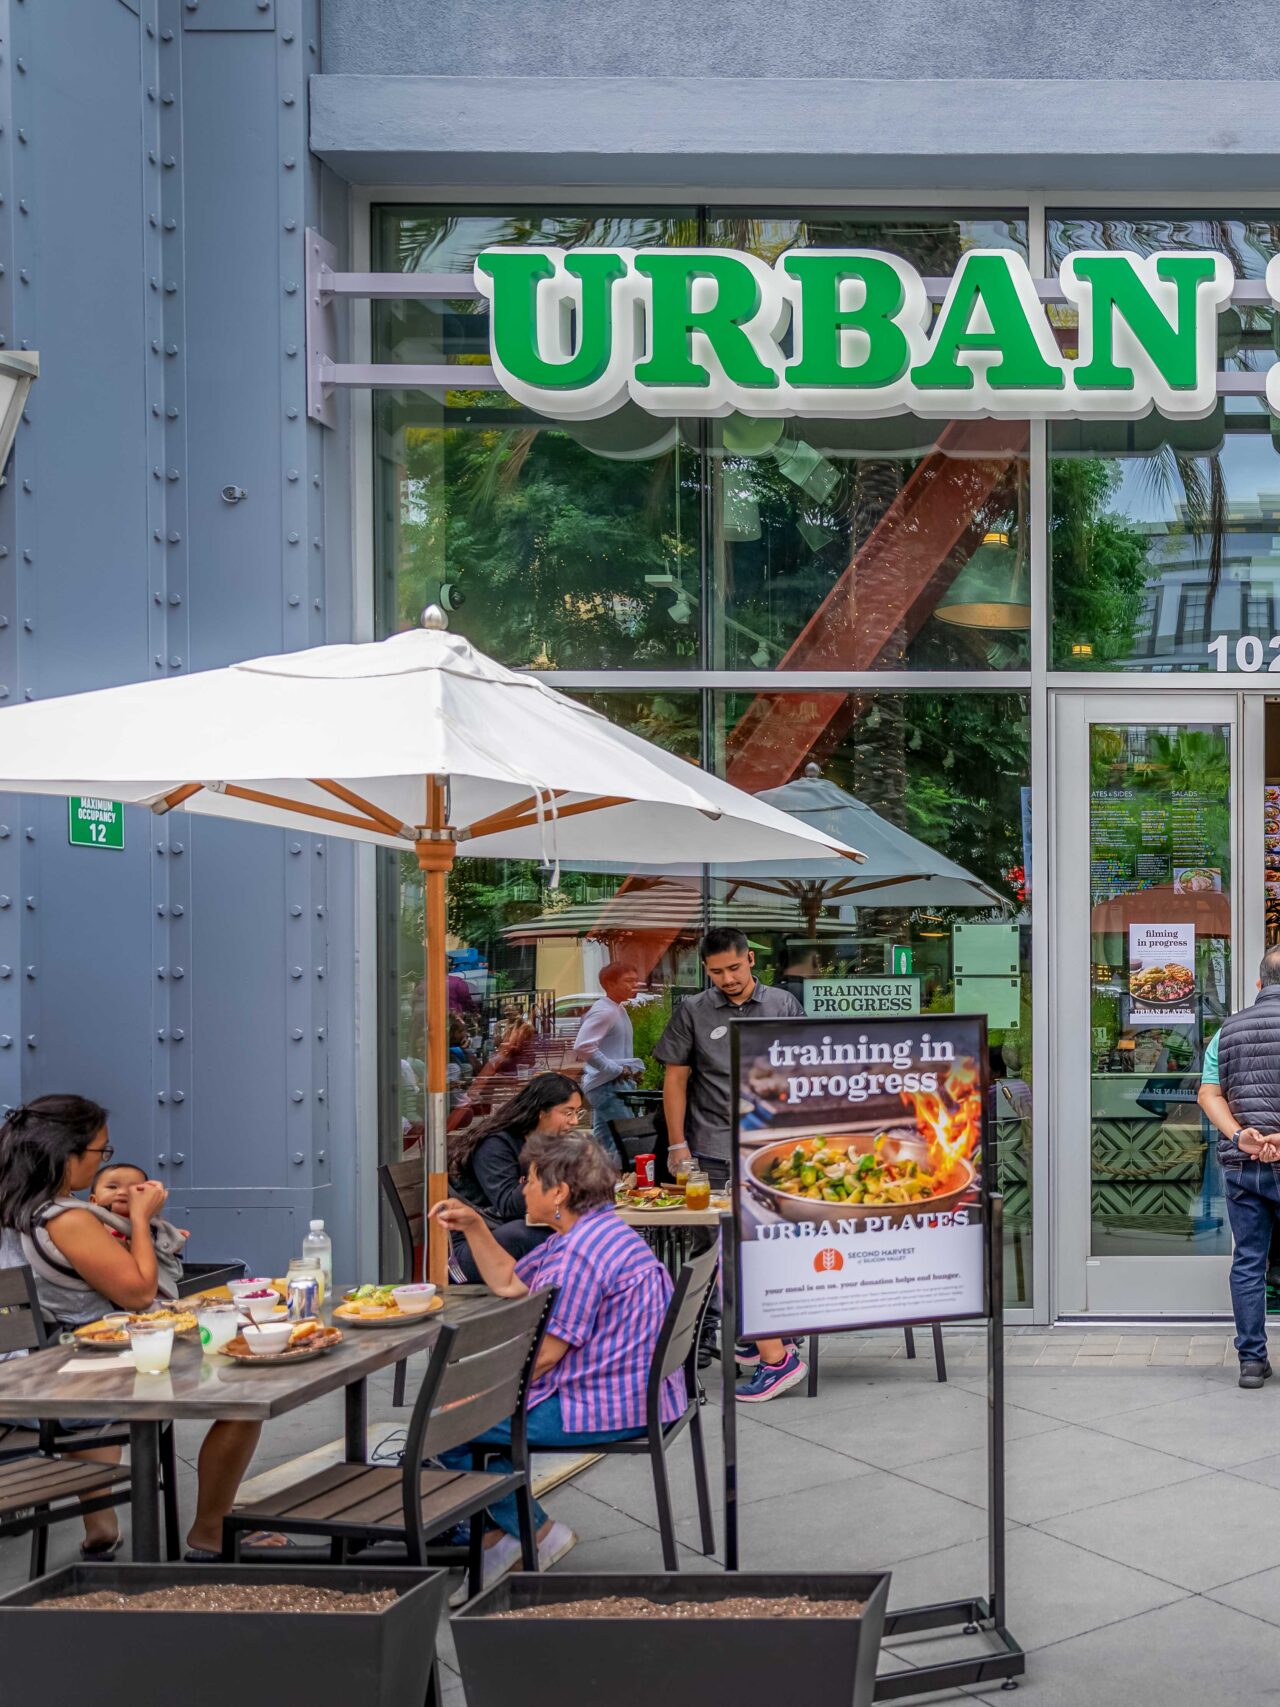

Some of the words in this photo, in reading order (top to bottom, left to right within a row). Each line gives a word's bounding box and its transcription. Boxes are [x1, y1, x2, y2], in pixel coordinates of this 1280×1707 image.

[477, 252, 1216, 392] URBAN
[78, 808, 116, 823] OCCUPANCY
[90, 823, 106, 842] 12
[1146, 930, 1178, 939] filming
[1149, 940, 1188, 948] progress
[813, 985, 892, 997] TRAINING
[894, 984, 912, 995] IN
[813, 997, 912, 1012] PROGRESS
[768, 1035, 913, 1069] training
[920, 1033, 955, 1061] in
[788, 1071, 938, 1104] progress
[755, 1218, 859, 1241] URBAN
[864, 1210, 969, 1232] PLATES
[848, 1250, 880, 1259] SECOND
[881, 1247, 915, 1256] HARVEST
[765, 1288, 783, 1296] your
[785, 1284, 804, 1292] meal
[860, 1277, 893, 1286] donation
[896, 1276, 915, 1284] helps
[933, 1273, 961, 1281] hunger.
